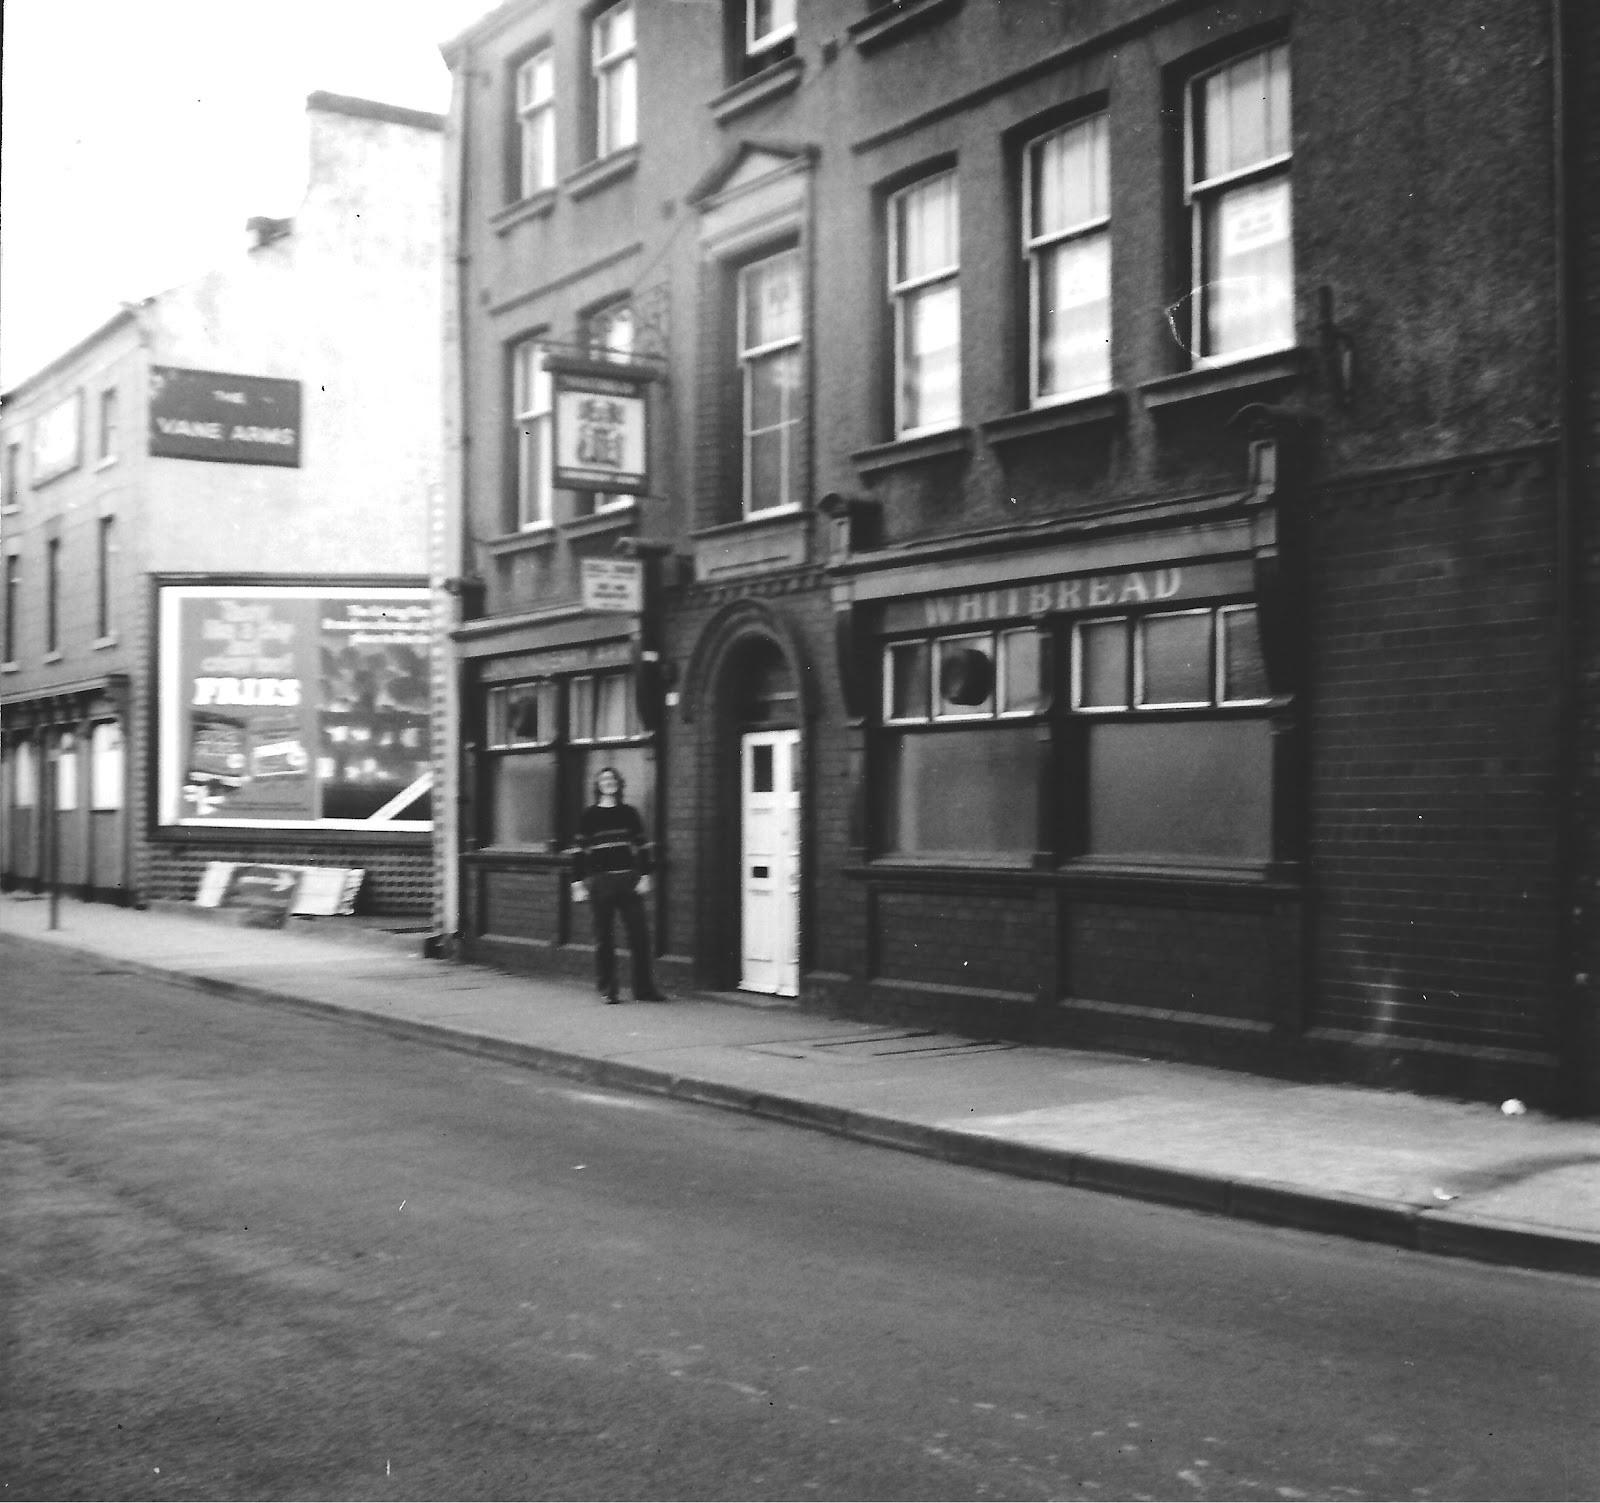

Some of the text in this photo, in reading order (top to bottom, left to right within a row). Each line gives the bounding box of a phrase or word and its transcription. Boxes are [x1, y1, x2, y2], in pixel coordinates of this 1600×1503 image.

[156, 416, 296, 446] VANE ARMS
[923, 566, 1183, 627] WHITBREAD
